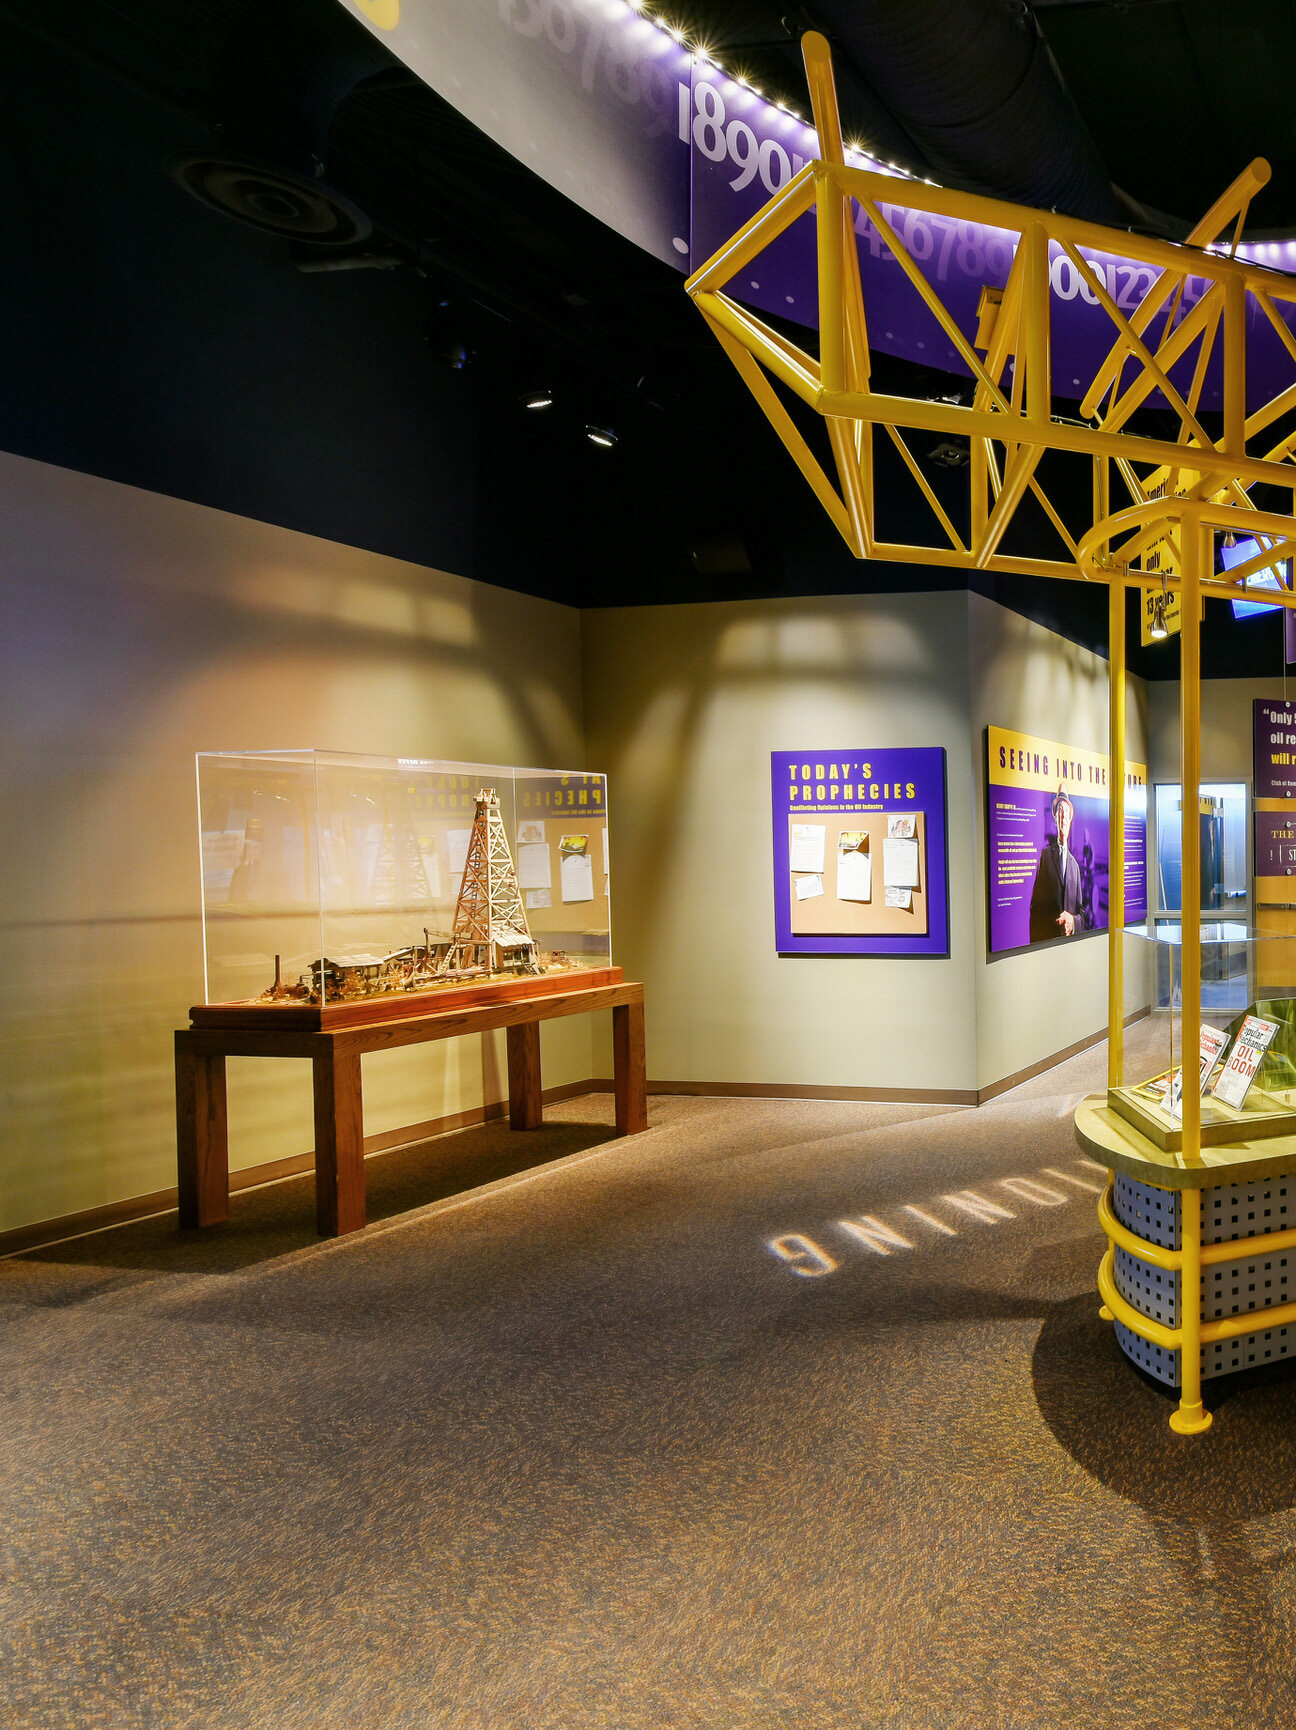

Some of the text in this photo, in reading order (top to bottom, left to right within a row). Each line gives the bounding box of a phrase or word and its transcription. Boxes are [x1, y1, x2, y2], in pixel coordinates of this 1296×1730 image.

[1270, 732, 1284, 744] oil
[998, 746, 1106, 785] SEEING INTO THE
[1271, 753, 1290, 765] will
[789, 783, 916, 801] PROPHECIES
[1271, 830, 1294, 839] THE
[1237, 1045, 1254, 1062] OIL
[1226, 1056, 1257, 1078] BOOM
